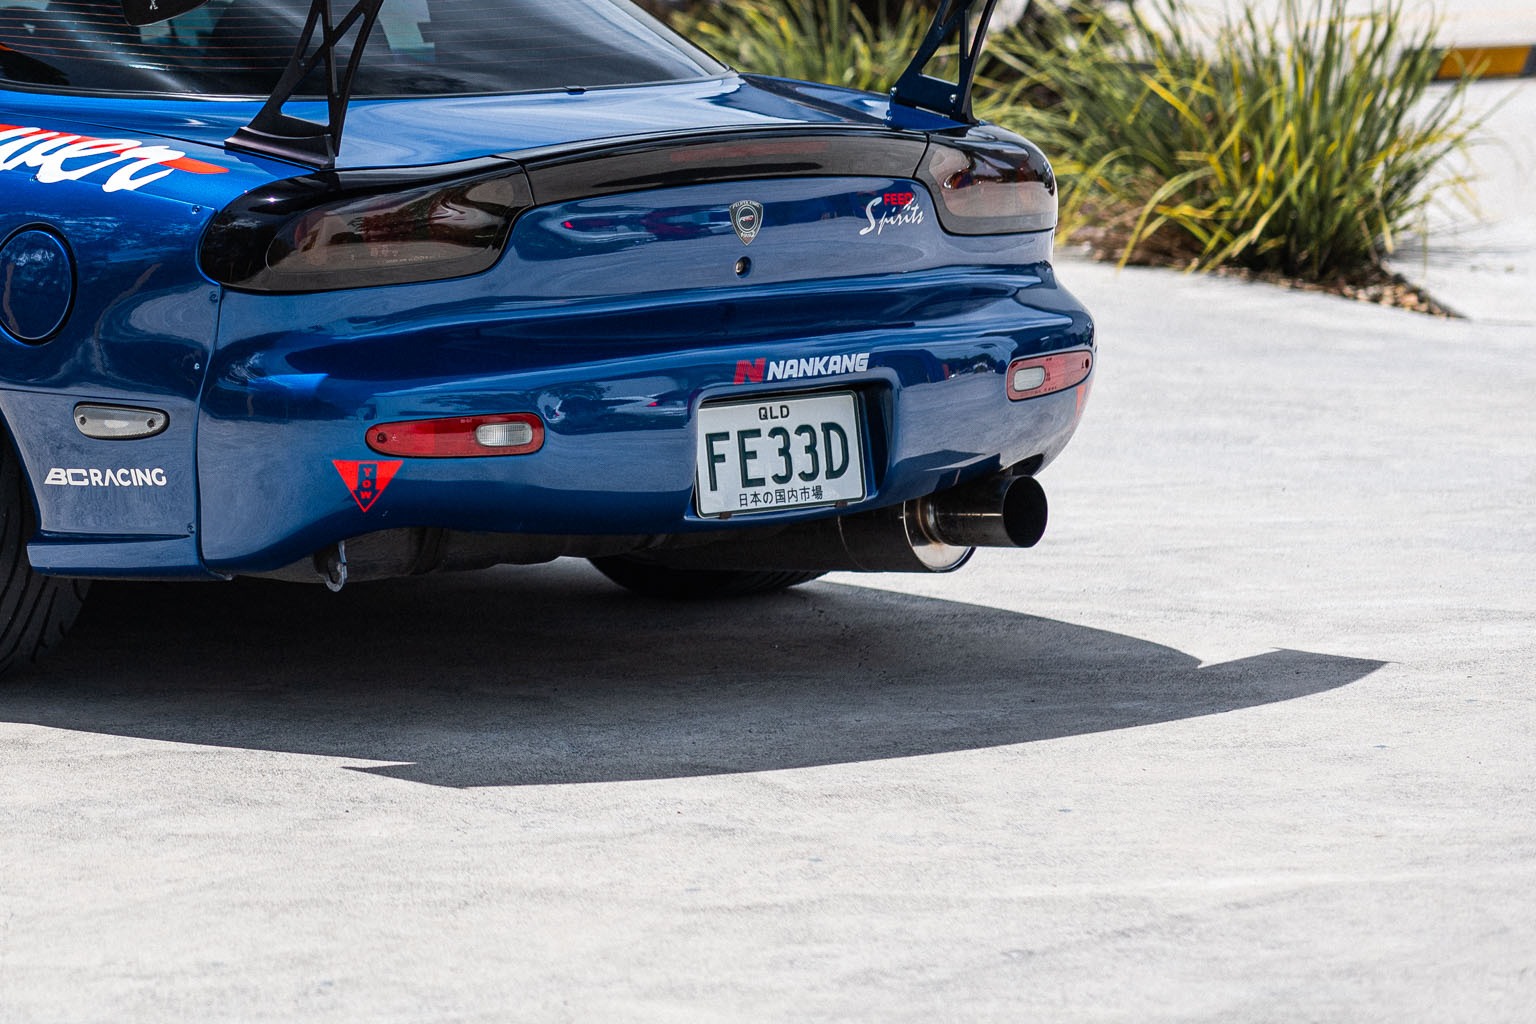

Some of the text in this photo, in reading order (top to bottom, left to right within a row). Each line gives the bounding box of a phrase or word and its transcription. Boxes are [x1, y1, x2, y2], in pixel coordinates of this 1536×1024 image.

[884, 192, 913, 206] FEED
[859, 195, 925, 236] Spirits
[767, 352, 870, 381] NANKANG
[758, 404, 790, 421] QLD
[704, 421, 850, 492] FE33D
[360, 467, 373, 499] TOW
[739, 485, 824, 508] 日本の国内市場
